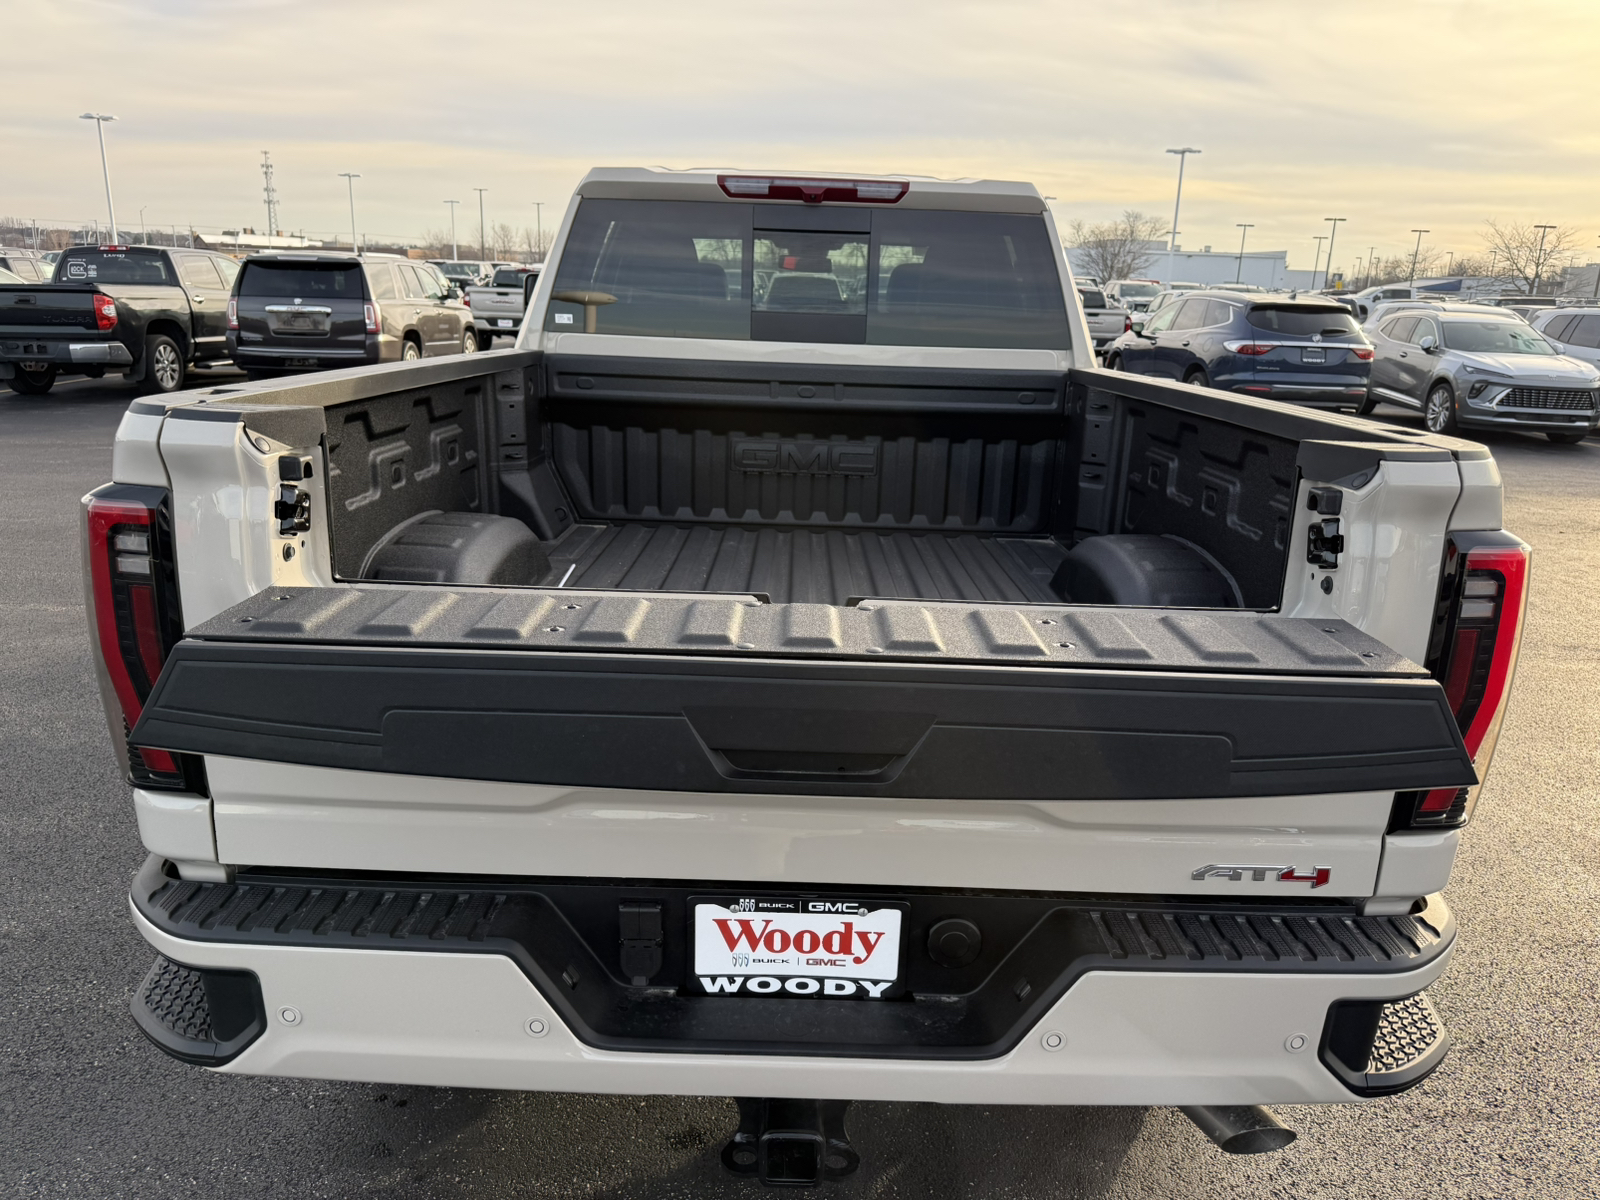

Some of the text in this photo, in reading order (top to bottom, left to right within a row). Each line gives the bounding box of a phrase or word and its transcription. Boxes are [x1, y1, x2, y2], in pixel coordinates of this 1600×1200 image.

[42, 315, 93, 323] TUNDRA
[734, 443, 875, 474] GMC
[1191, 863, 1332, 889] AT4
[808, 901, 859, 913] GMC
[712, 918, 885, 965] Woody
[805, 957, 847, 967] GMC
[699, 976, 892, 998] WOODY
